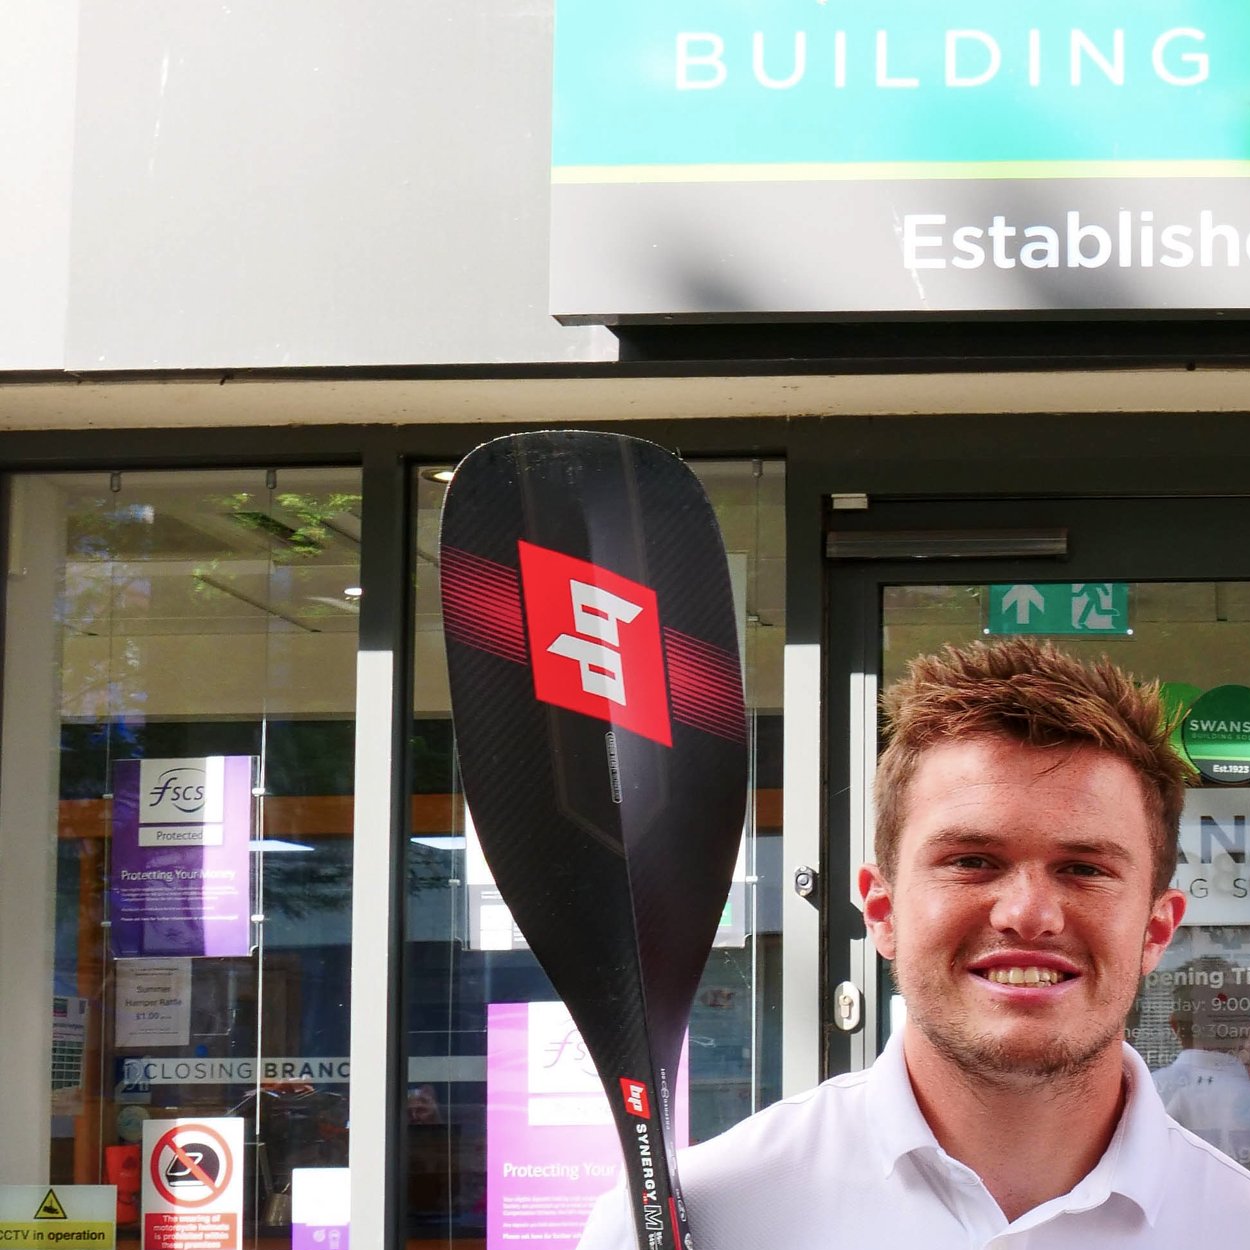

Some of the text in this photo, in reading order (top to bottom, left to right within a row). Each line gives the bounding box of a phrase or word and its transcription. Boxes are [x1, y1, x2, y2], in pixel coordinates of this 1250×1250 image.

[672, 27, 1211, 90] BUILDING
[156, 831, 203, 841] Protected
[121, 870, 173, 882] Protecting
[175, 869, 198, 879] Your
[1144, 967, 1224, 988] pening
[145, 1062, 253, 1080] CLOSING
[503, 1162, 616, 1180] Protecting Your
[636, 1123, 657, 1201] SYNERGY
[33, 1230, 44, 1240] in
[48, 1229, 105, 1243] operation
